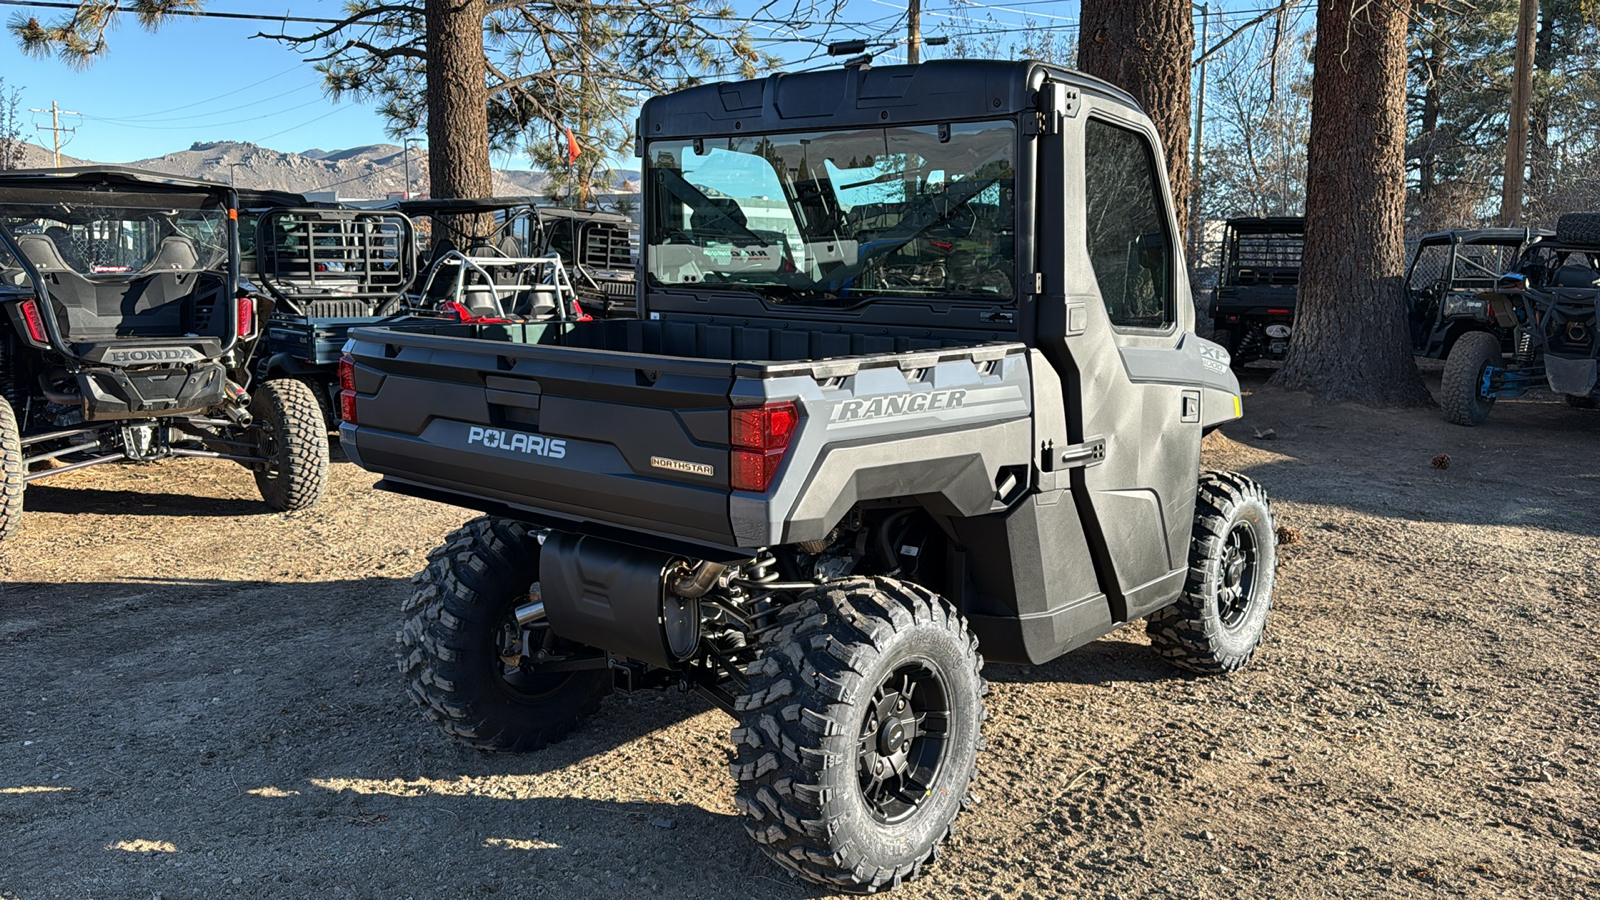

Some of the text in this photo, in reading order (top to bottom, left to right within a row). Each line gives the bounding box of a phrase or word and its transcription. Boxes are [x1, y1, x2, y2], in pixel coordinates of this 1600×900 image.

[112, 349, 197, 362] HONDA
[1200, 344, 1227, 360] XP
[837, 389, 967, 421] RANGER
[468, 426, 567, 459] POLARIS
[652, 457, 712, 475] NORTHSTAR
